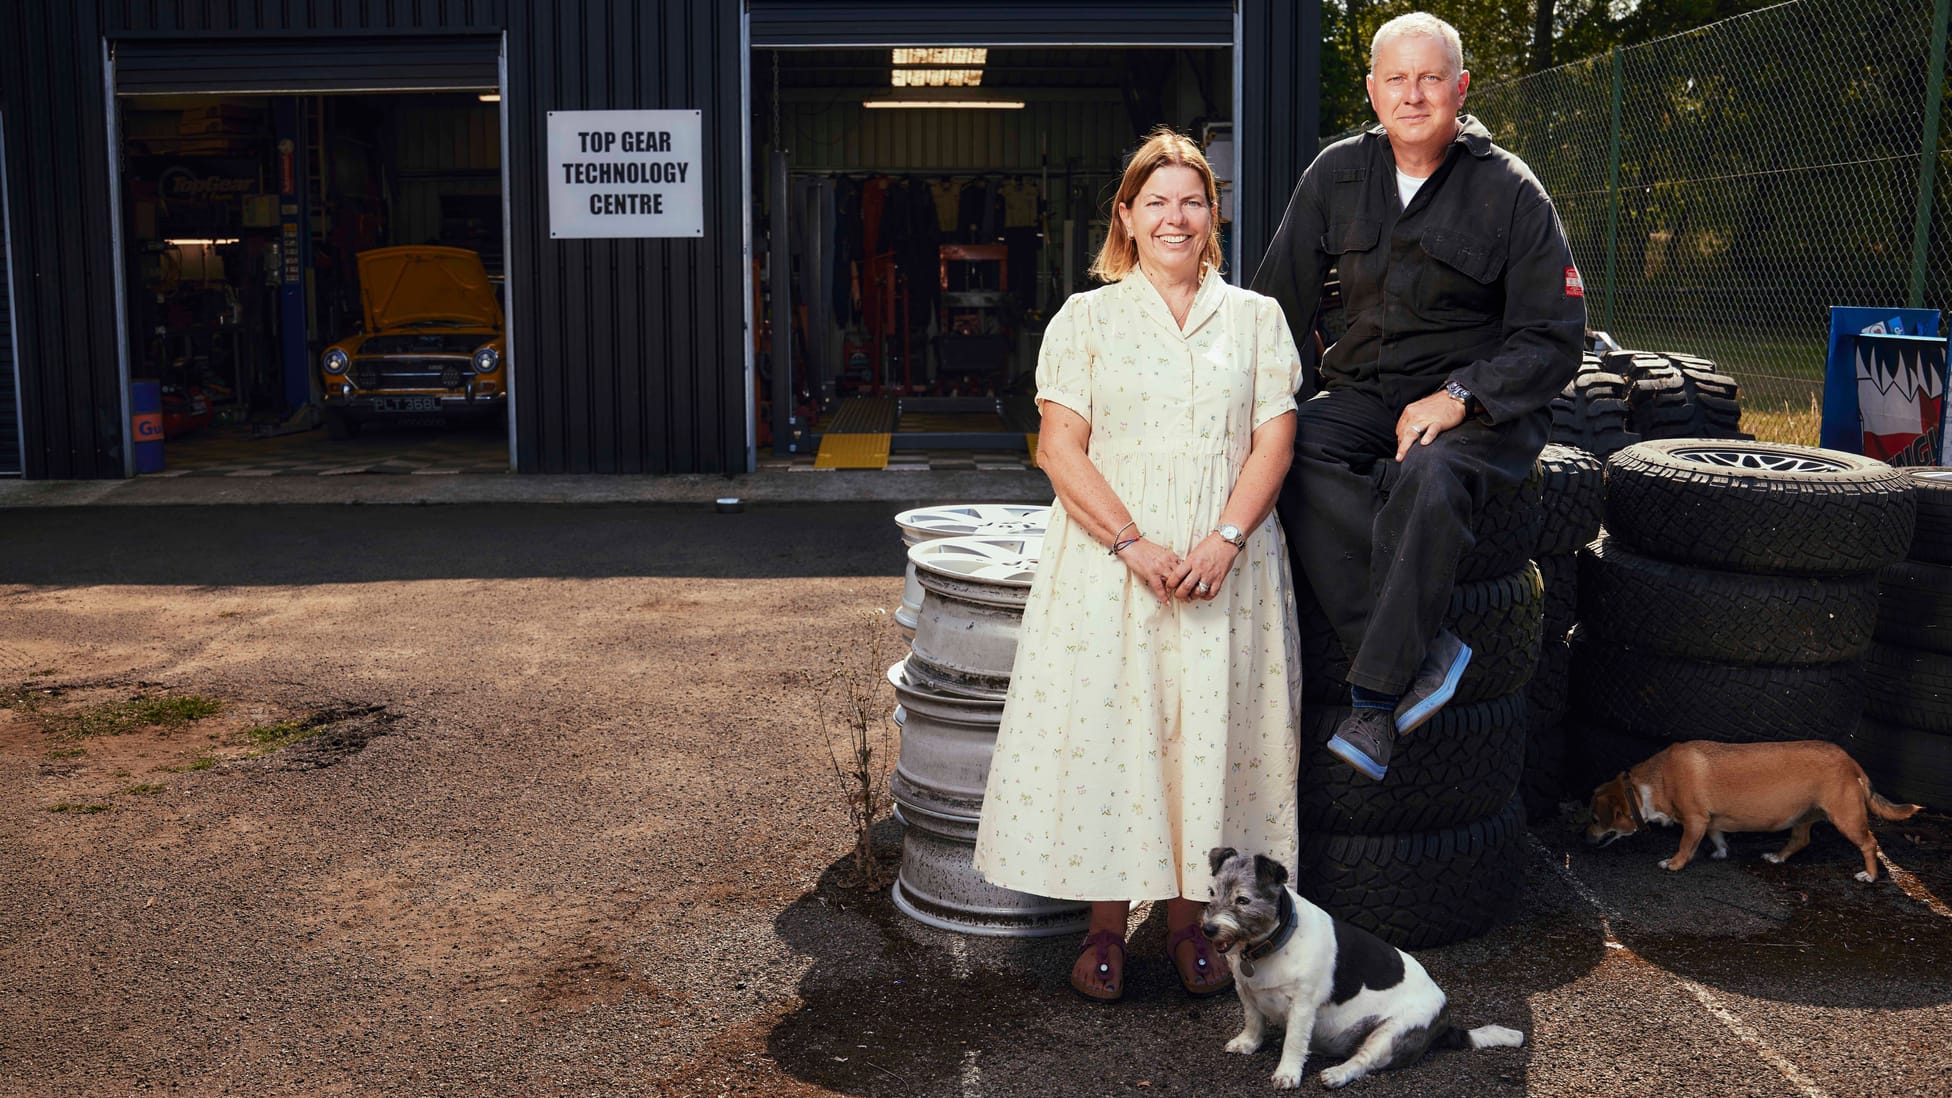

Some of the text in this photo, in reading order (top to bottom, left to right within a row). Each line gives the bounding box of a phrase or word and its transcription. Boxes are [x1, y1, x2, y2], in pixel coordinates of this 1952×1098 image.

[578, 131, 671, 153] TOP GEAR
[562, 162, 689, 184] TECHNOLOGY
[590, 194, 663, 215] CENTRE
[375, 398, 401, 410] PLT
